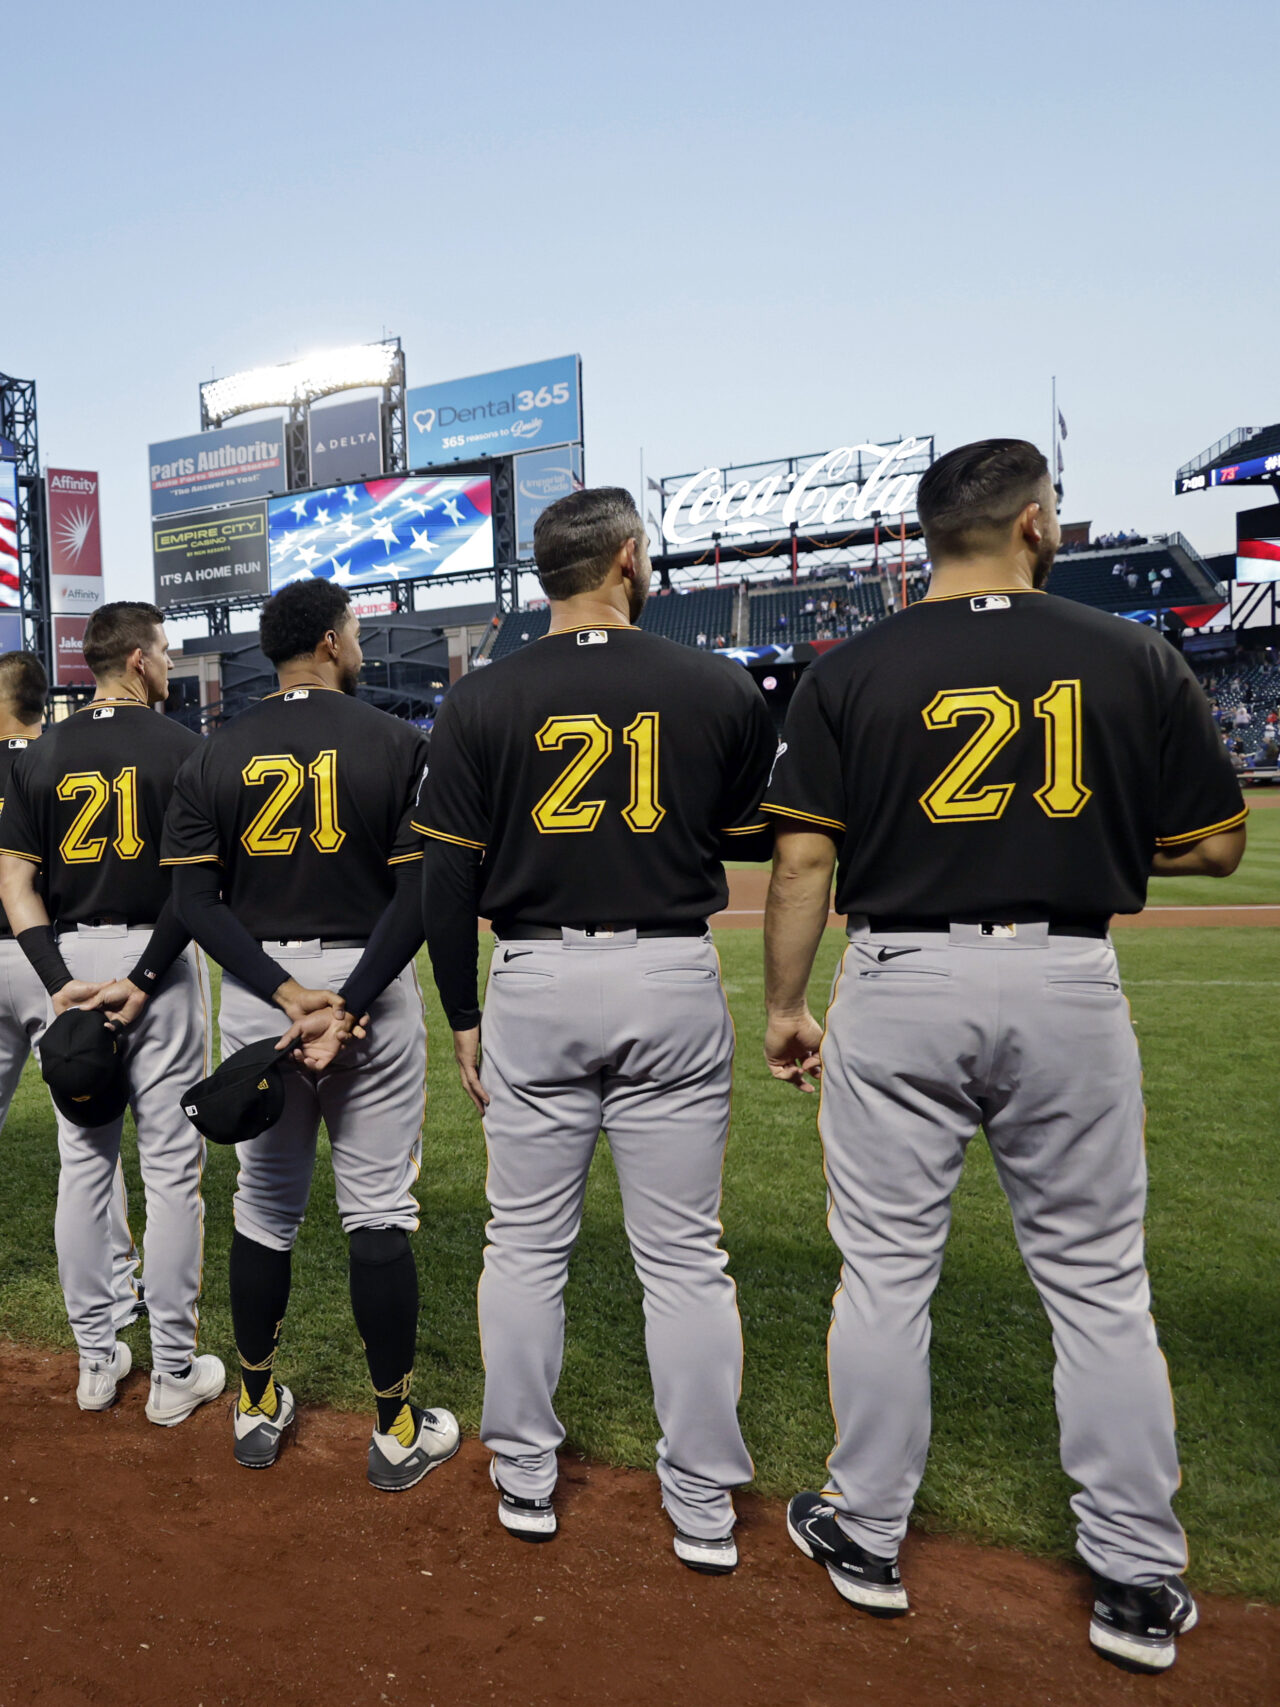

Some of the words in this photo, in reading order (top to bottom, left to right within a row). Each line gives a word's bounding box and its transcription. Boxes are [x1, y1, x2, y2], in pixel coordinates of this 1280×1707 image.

[330, 432, 376, 449] DELTA
[441, 434, 465, 450] 365
[466, 432, 498, 443] reasons
[500, 428, 509, 437] to
[151, 458, 195, 481] Parts
[198, 441, 280, 472] Authority
[50, 475, 97, 495] Affinity
[160, 528, 218, 545] EMPIRE
[221, 521, 257, 535] CITY
[190, 536, 226, 548] CASINO
[160, 573, 182, 586] IT'S
[184, 571, 194, 582] A
[195, 565, 232, 581] HOME
[234, 561, 261, 575] RUN
[67, 589, 99, 601] Affinity
[352, 601, 398, 615] alance
[59, 636, 83, 649] Jake
[919, 679, 1092, 823] 21
[531, 711, 666, 833] 21
[241, 750, 346, 856] 21
[56, 767, 144, 864] 21
